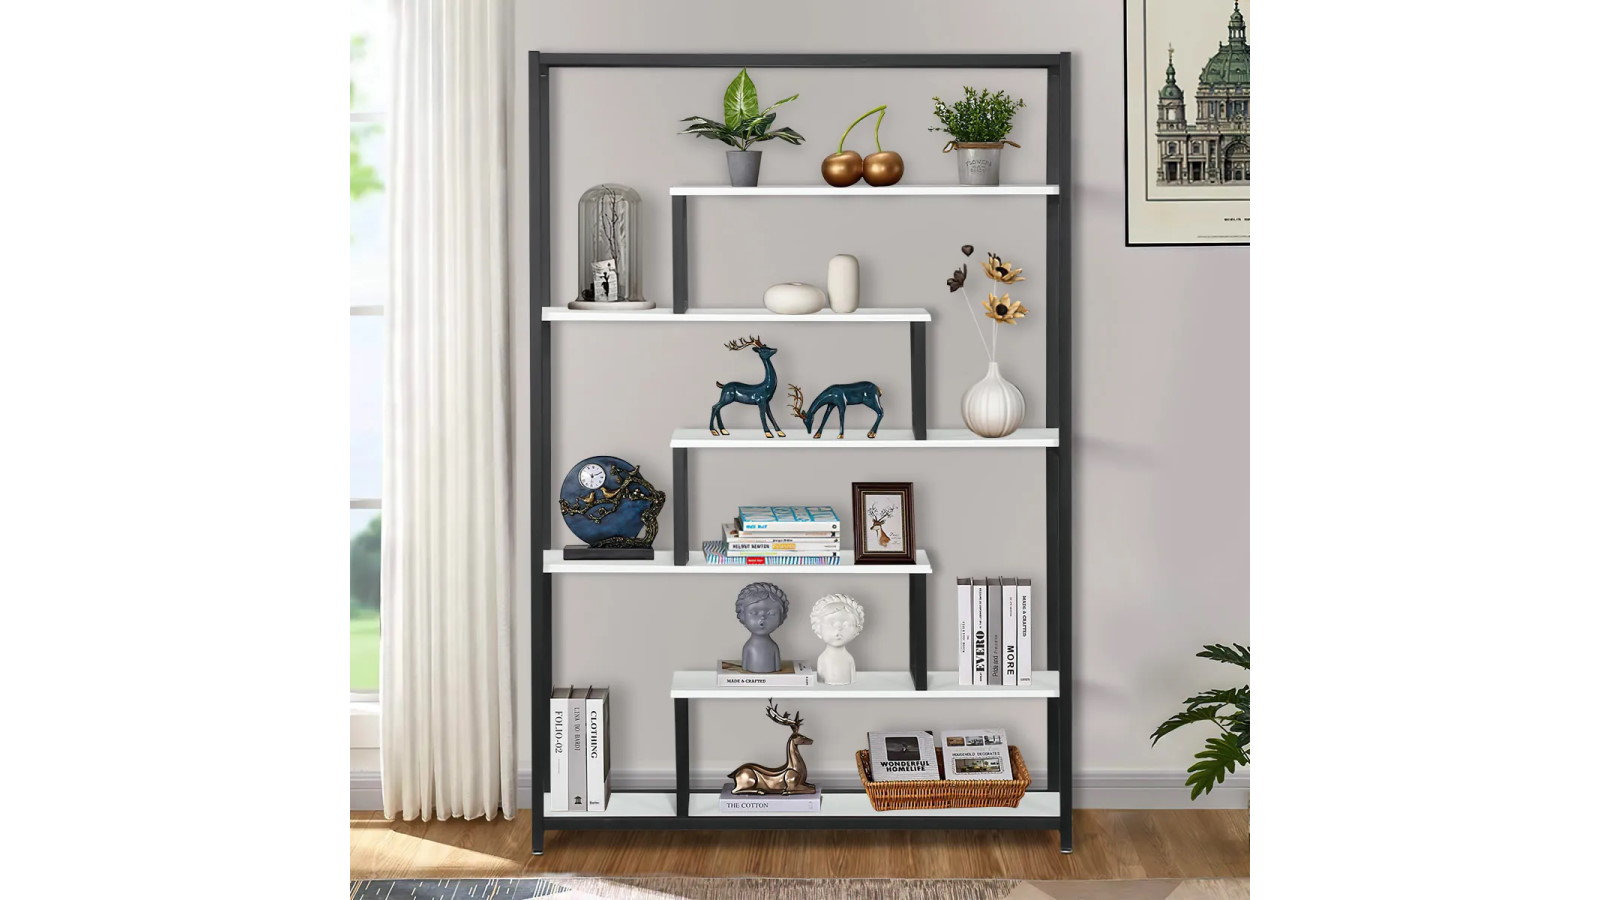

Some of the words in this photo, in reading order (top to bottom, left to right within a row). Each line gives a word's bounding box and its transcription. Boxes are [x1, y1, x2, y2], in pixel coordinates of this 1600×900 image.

[976, 630, 985, 672] EVERO
[1006, 645, 1014, 675] MORE
[555, 711, 563, 754] FOLIO-02
